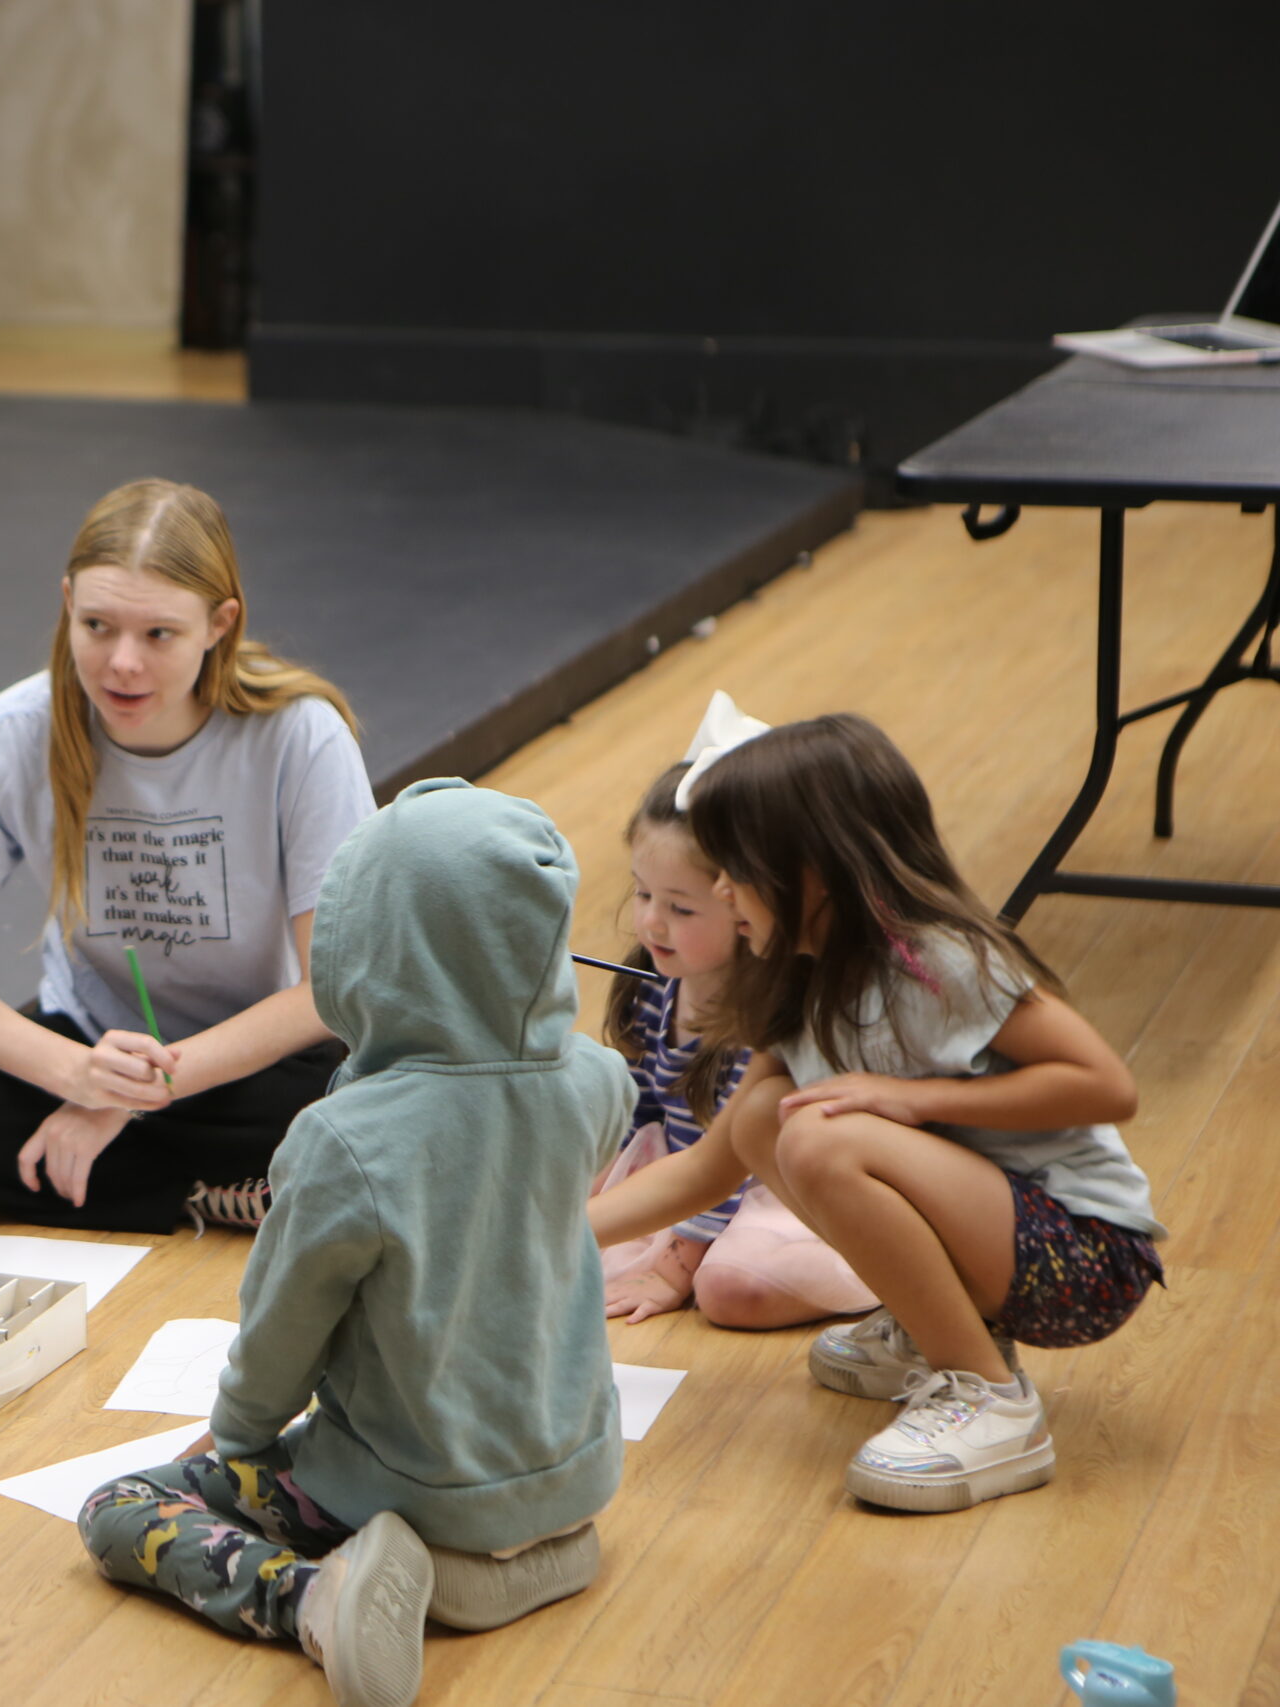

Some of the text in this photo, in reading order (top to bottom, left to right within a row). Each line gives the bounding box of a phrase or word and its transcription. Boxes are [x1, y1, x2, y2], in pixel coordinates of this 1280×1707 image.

[112, 831, 136, 843] not
[143, 830, 164, 847] the
[172, 828, 225, 847] magic
[102, 847, 206, 867] that makes it
[106, 885, 207, 907] it's the work
[104, 905, 210, 927] that makes it
[121, 926, 197, 957] magic
